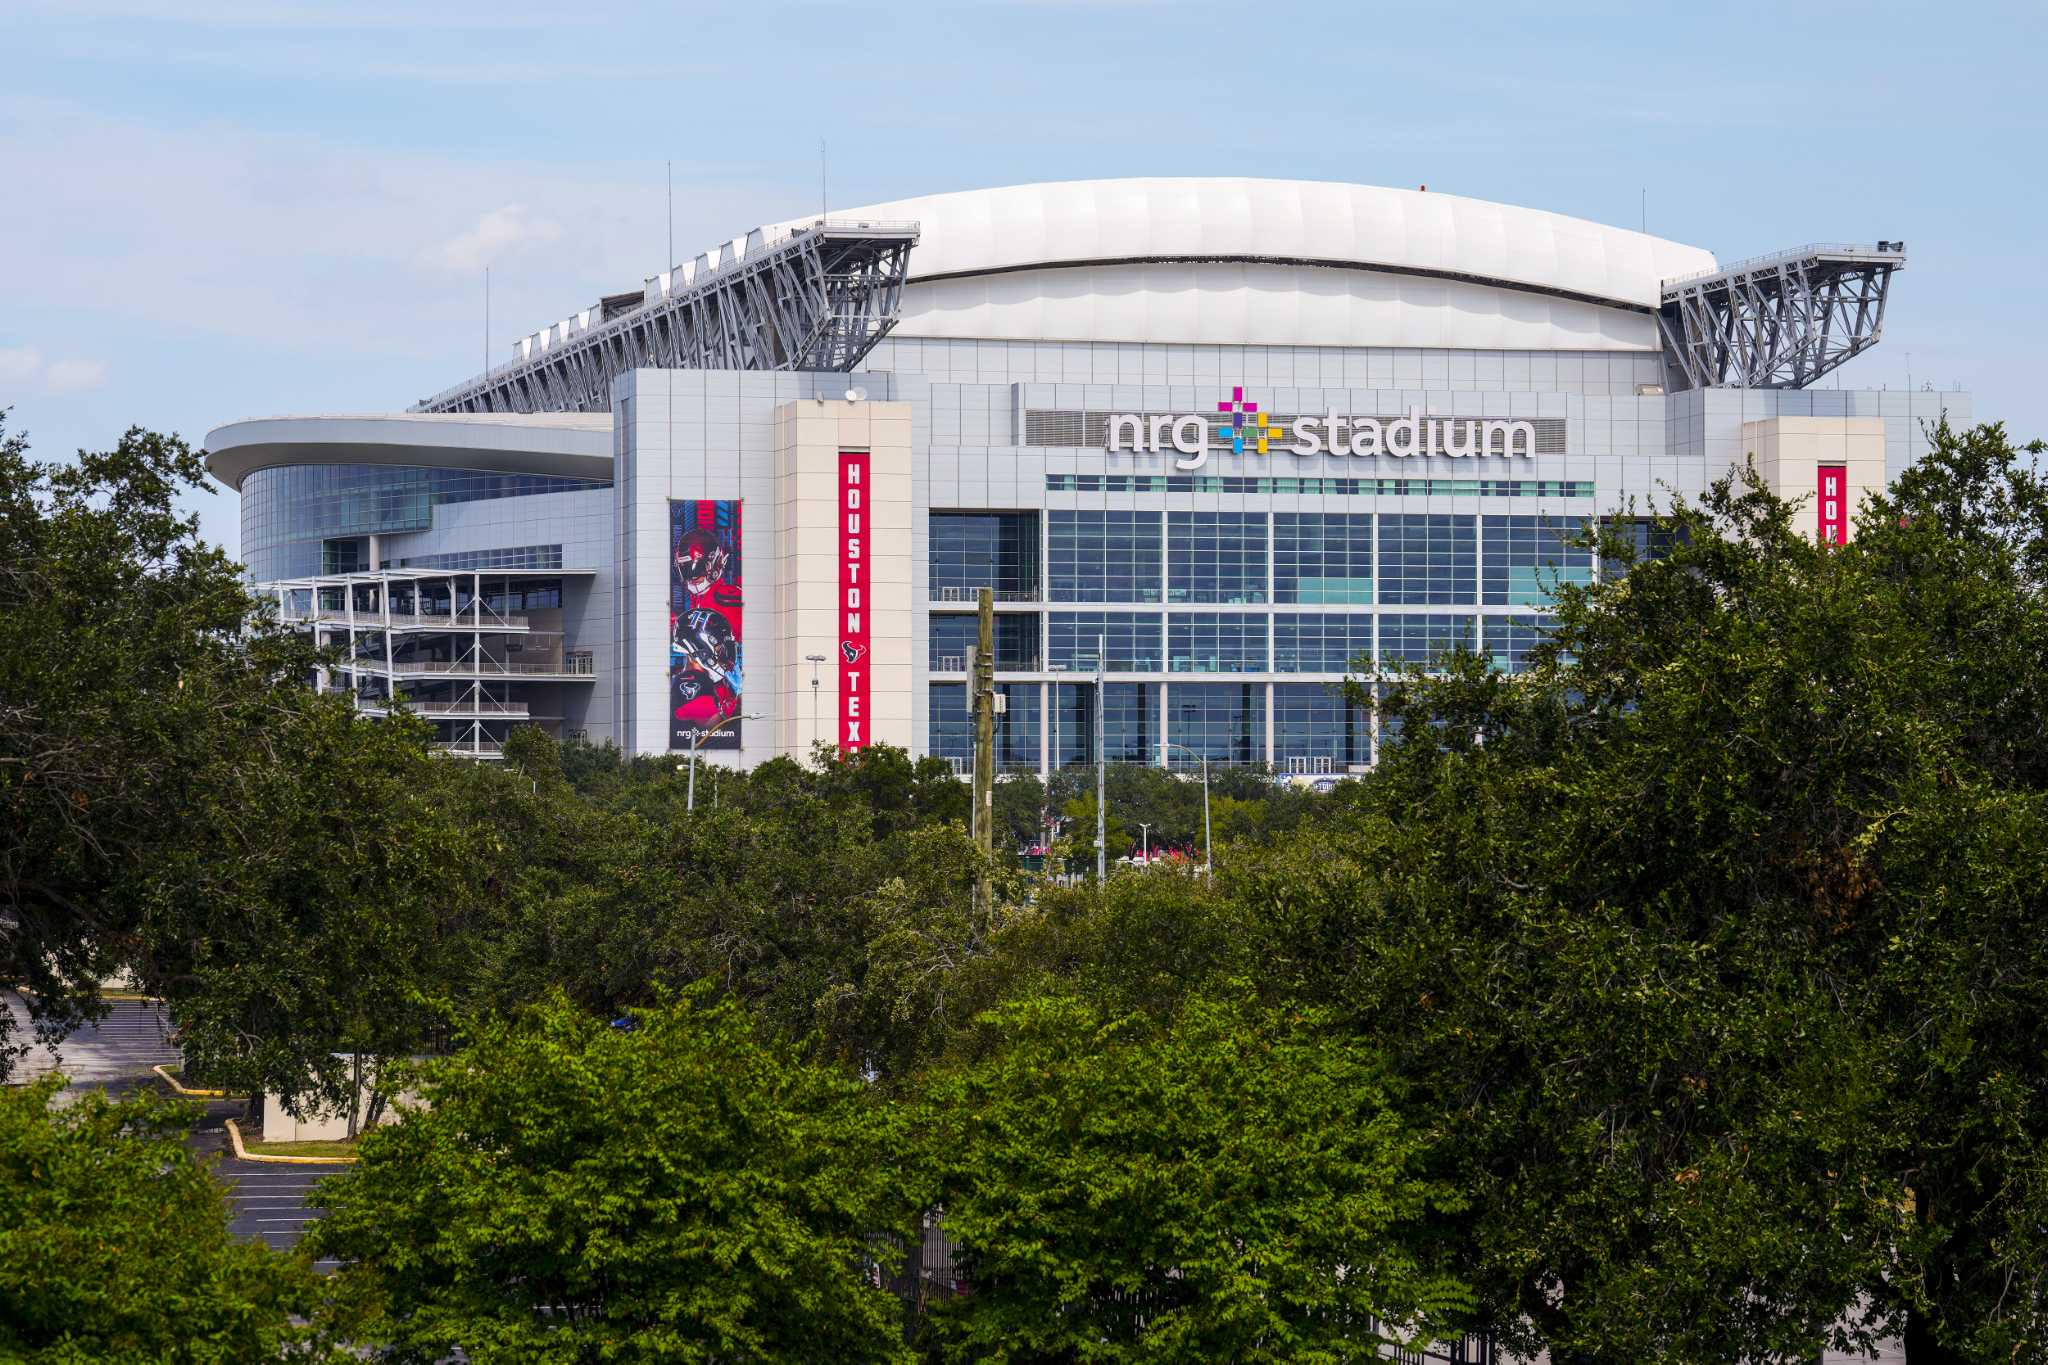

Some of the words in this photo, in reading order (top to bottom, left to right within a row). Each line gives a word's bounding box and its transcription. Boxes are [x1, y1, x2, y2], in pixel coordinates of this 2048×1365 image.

[1110, 414, 1208, 470] nrg
[1291, 405, 1535, 458] stadium
[848, 464, 860, 633] HOUSTON
[1826, 477, 1837, 556] HOU
[677, 730, 691, 739] nrg
